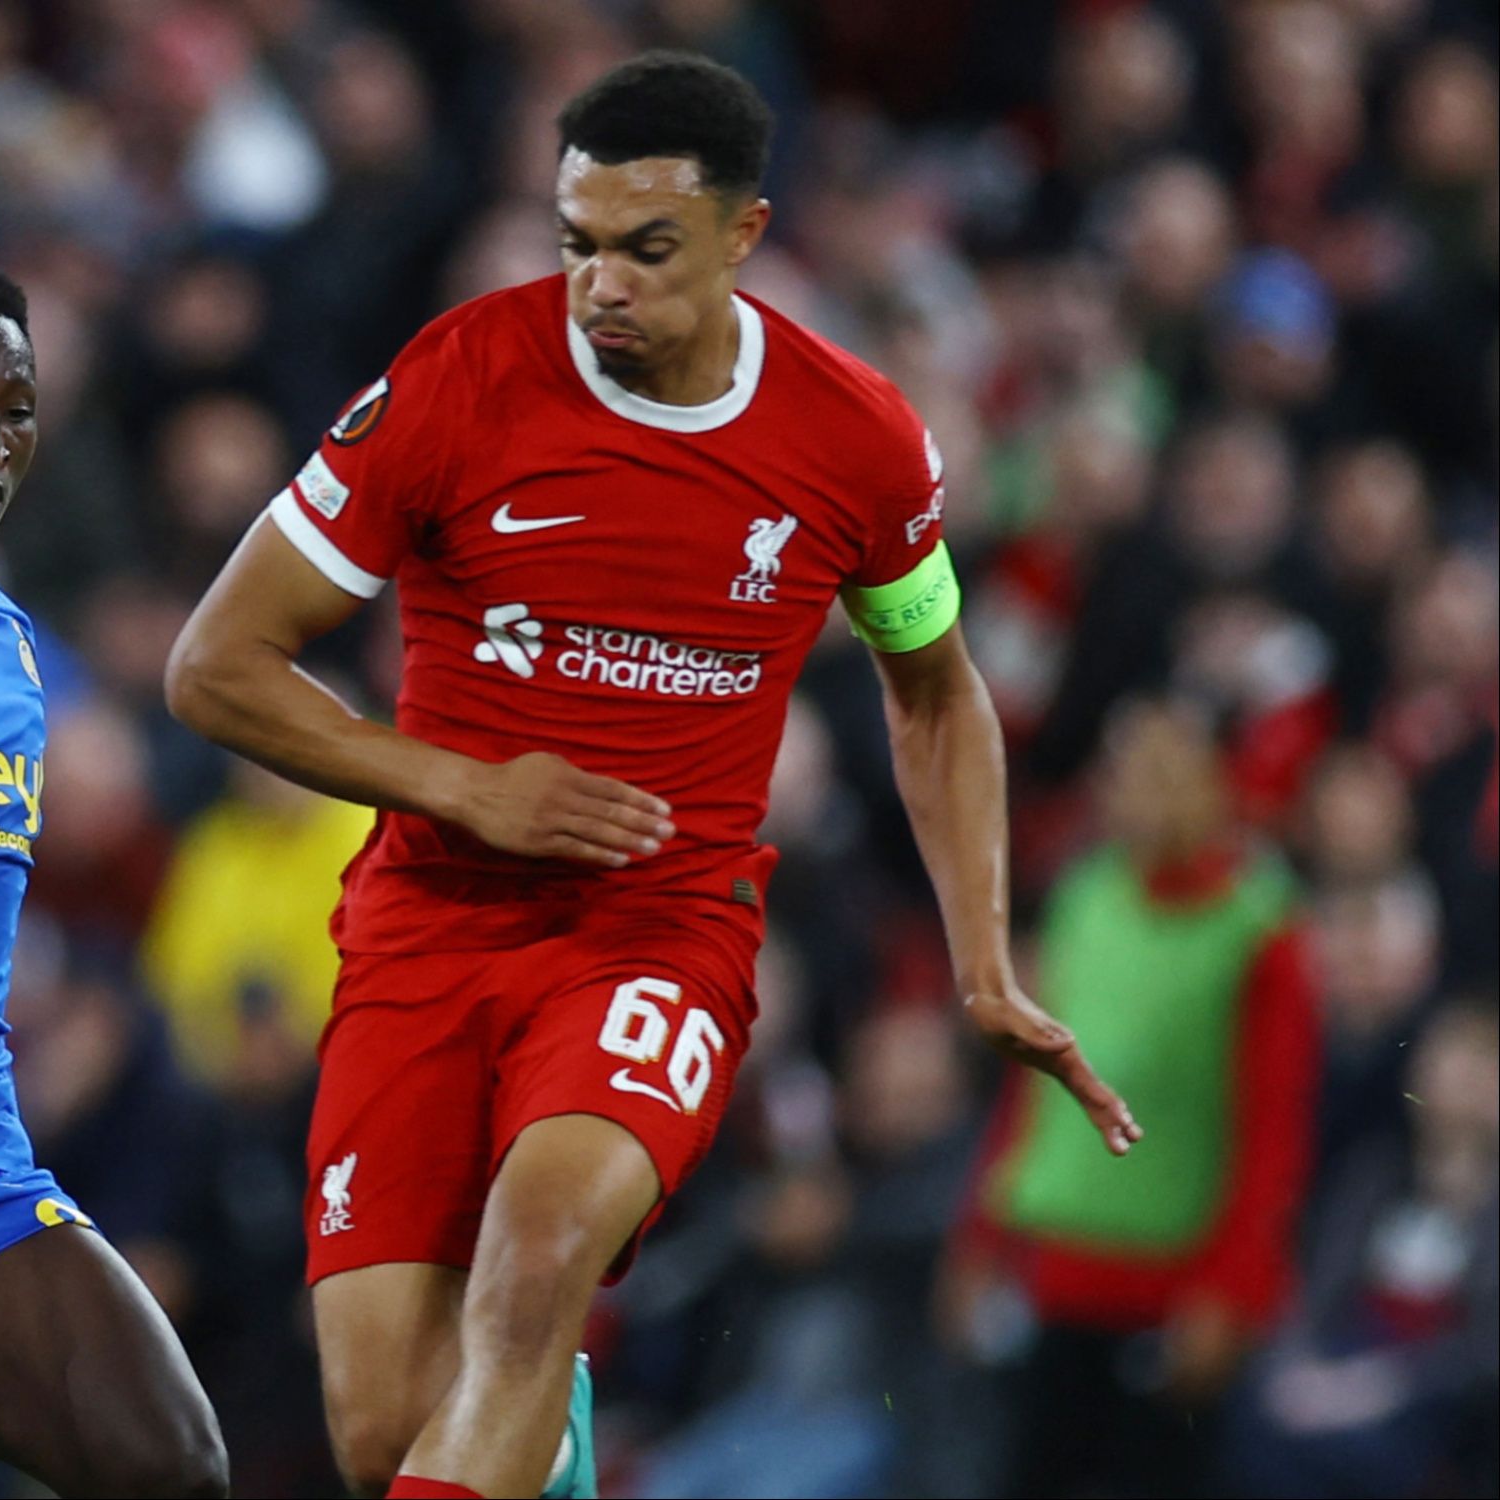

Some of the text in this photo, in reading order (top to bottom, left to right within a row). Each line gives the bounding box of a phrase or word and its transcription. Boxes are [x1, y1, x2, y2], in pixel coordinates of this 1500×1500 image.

[729, 580, 777, 603] LFC
[556, 650, 761, 696] chartered
[598, 976, 725, 1115] 66
[320, 1213, 356, 1236] LFC
